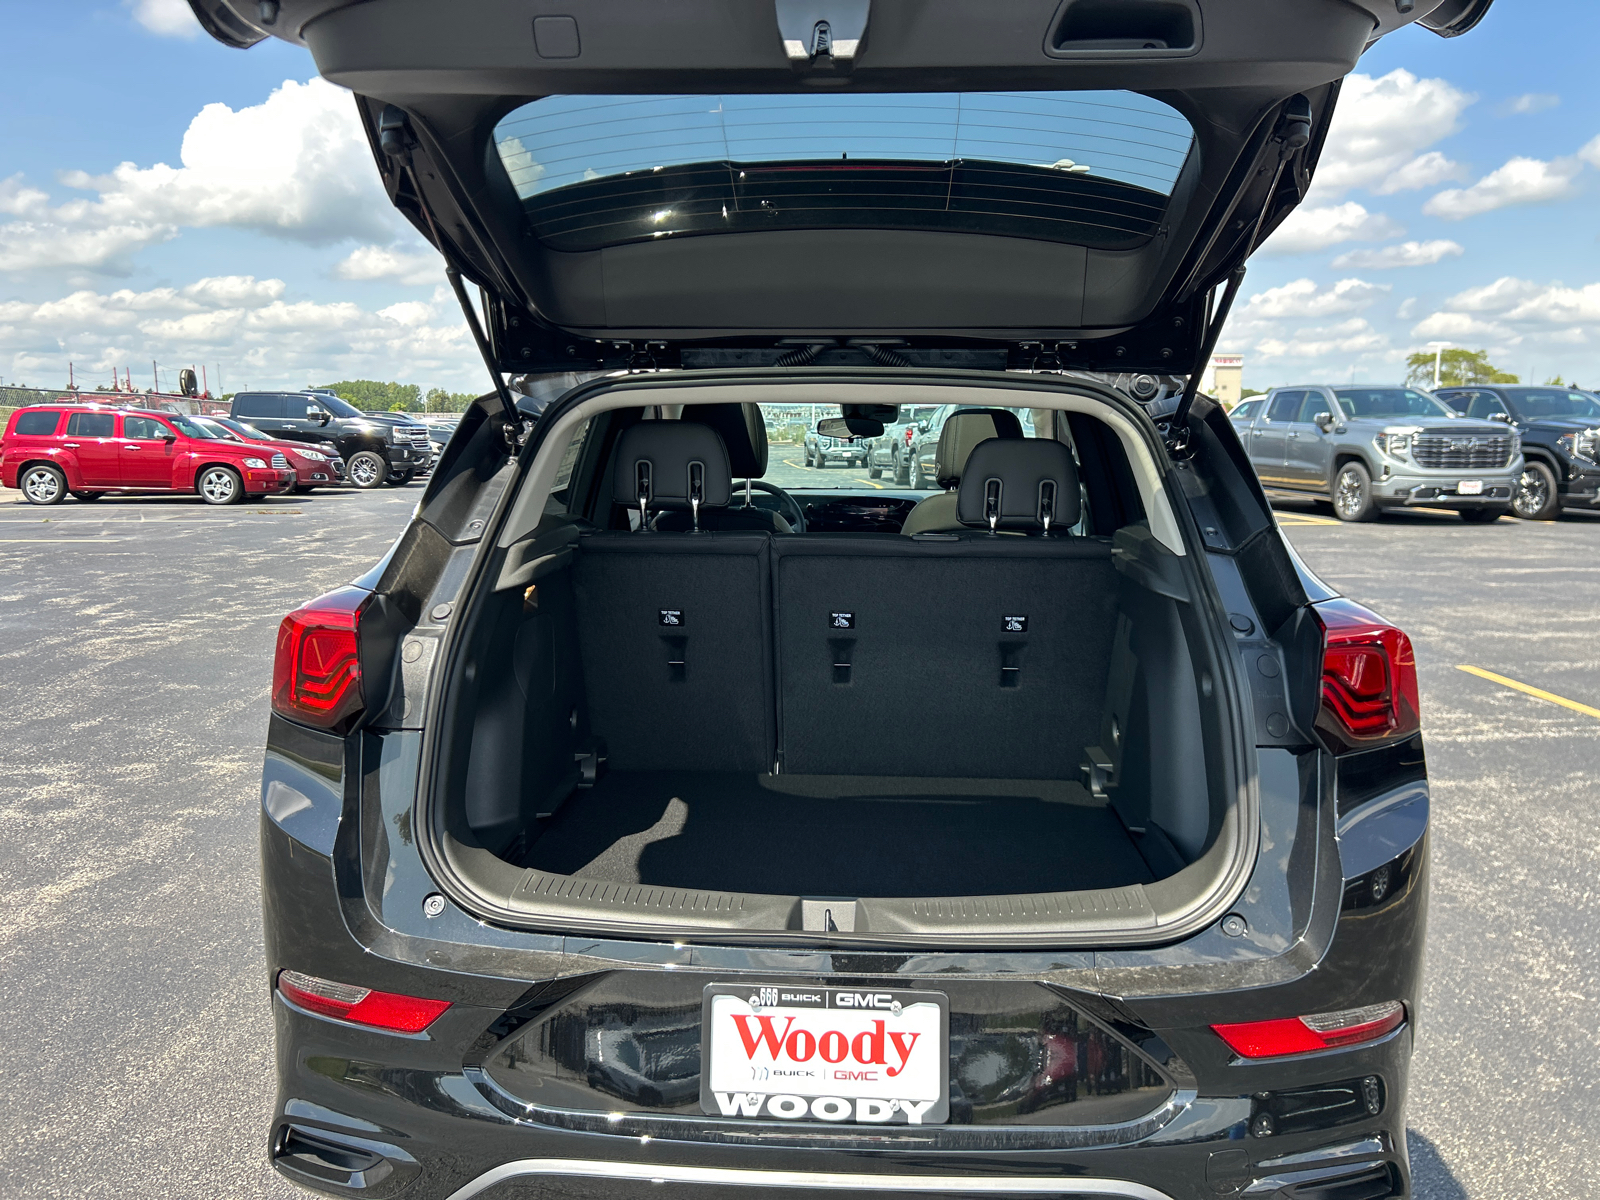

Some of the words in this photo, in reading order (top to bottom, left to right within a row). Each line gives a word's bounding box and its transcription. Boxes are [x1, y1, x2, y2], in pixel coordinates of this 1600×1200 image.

[781, 993, 821, 1002] BUICK
[835, 992, 892, 1008] GMC
[730, 1014, 921, 1077] Woody
[773, 1069, 815, 1077] BUICK
[833, 1070, 878, 1081] GMC
[713, 1092, 937, 1125] WOODY
